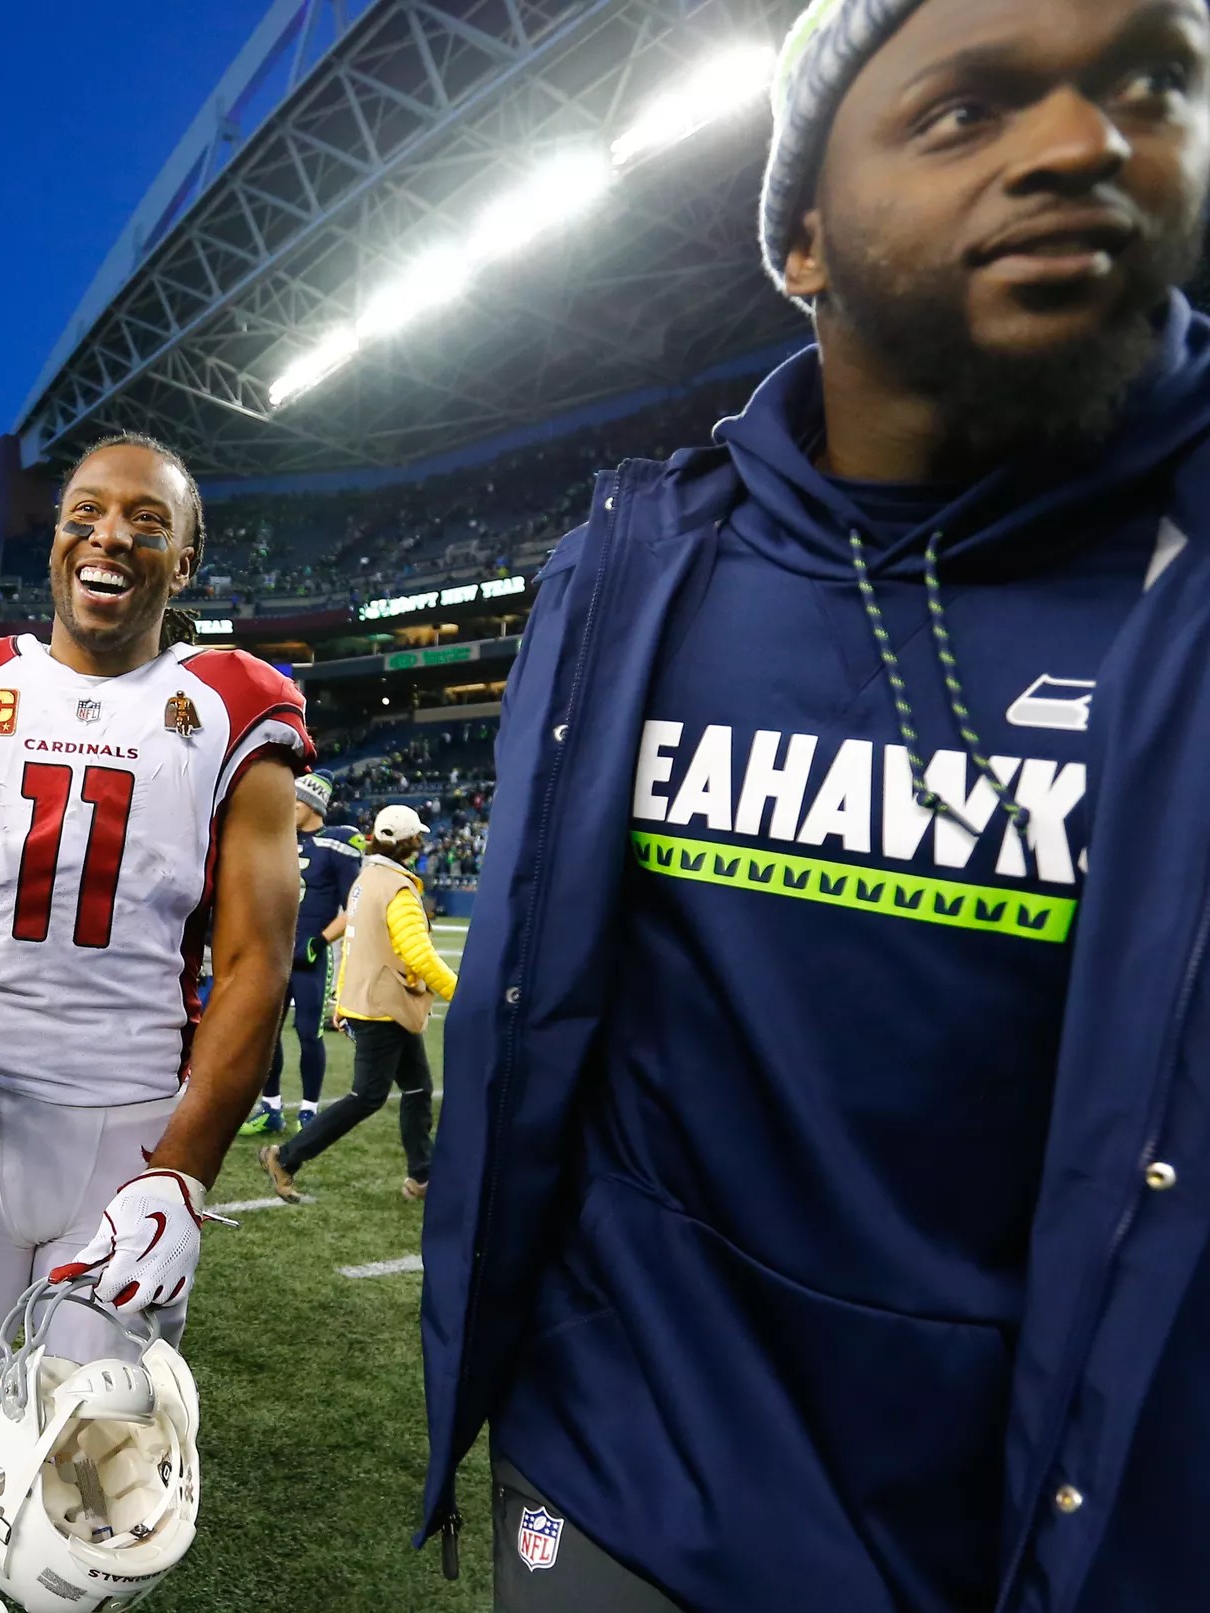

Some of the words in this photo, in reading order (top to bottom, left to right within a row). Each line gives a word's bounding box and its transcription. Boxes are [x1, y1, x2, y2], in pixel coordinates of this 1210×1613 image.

[441, 584, 478, 606] NEW
[480, 576, 526, 599] YEAR
[24, 738, 139, 759] CARDINALS
[633, 720, 1088, 885] EAHAWK
[12, 761, 135, 949] 11
[521, 1530, 551, 1561] NFL
